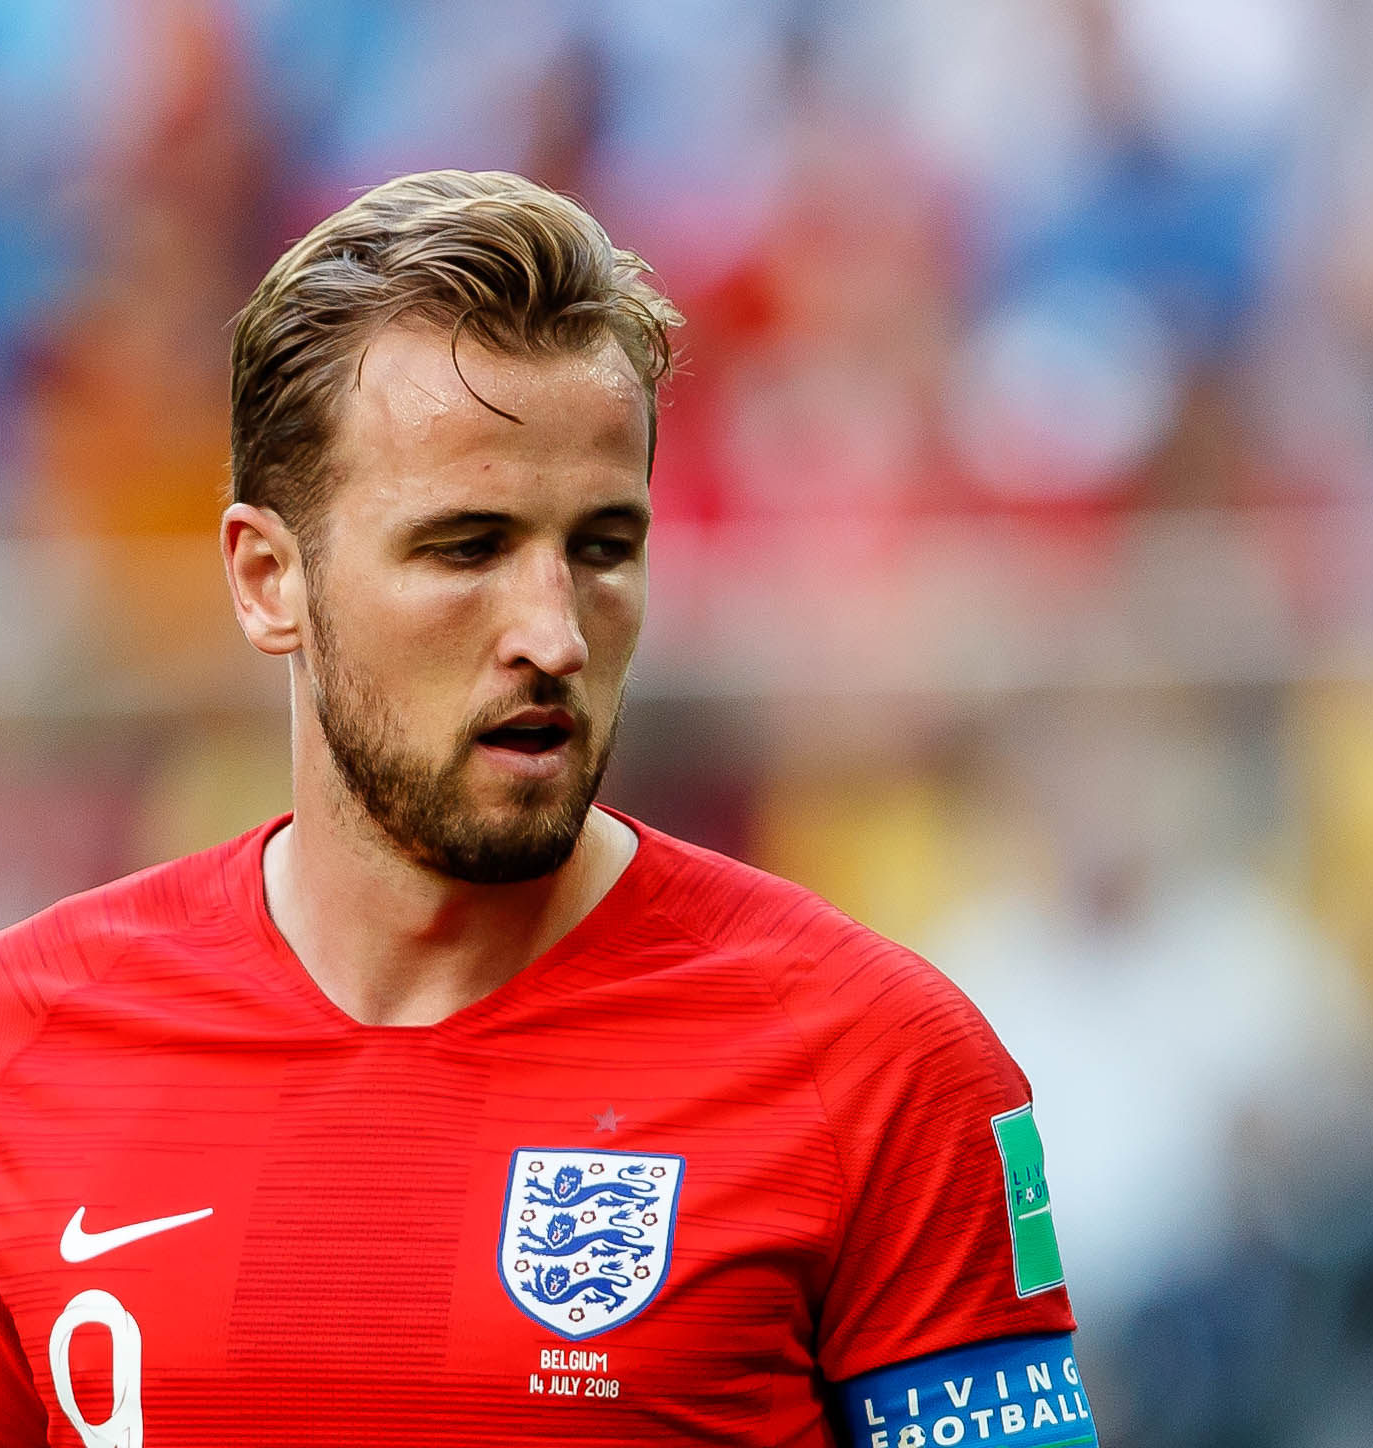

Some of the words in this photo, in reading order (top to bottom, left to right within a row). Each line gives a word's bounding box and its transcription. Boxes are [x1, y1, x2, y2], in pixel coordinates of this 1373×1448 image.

[540, 1349, 608, 1373] BELGIUM
[529, 1373, 544, 1394] 14
[548, 1375, 581, 1396] JULY
[584, 1377, 620, 1399] 2018
[864, 1356, 1079, 1426] LIVING
